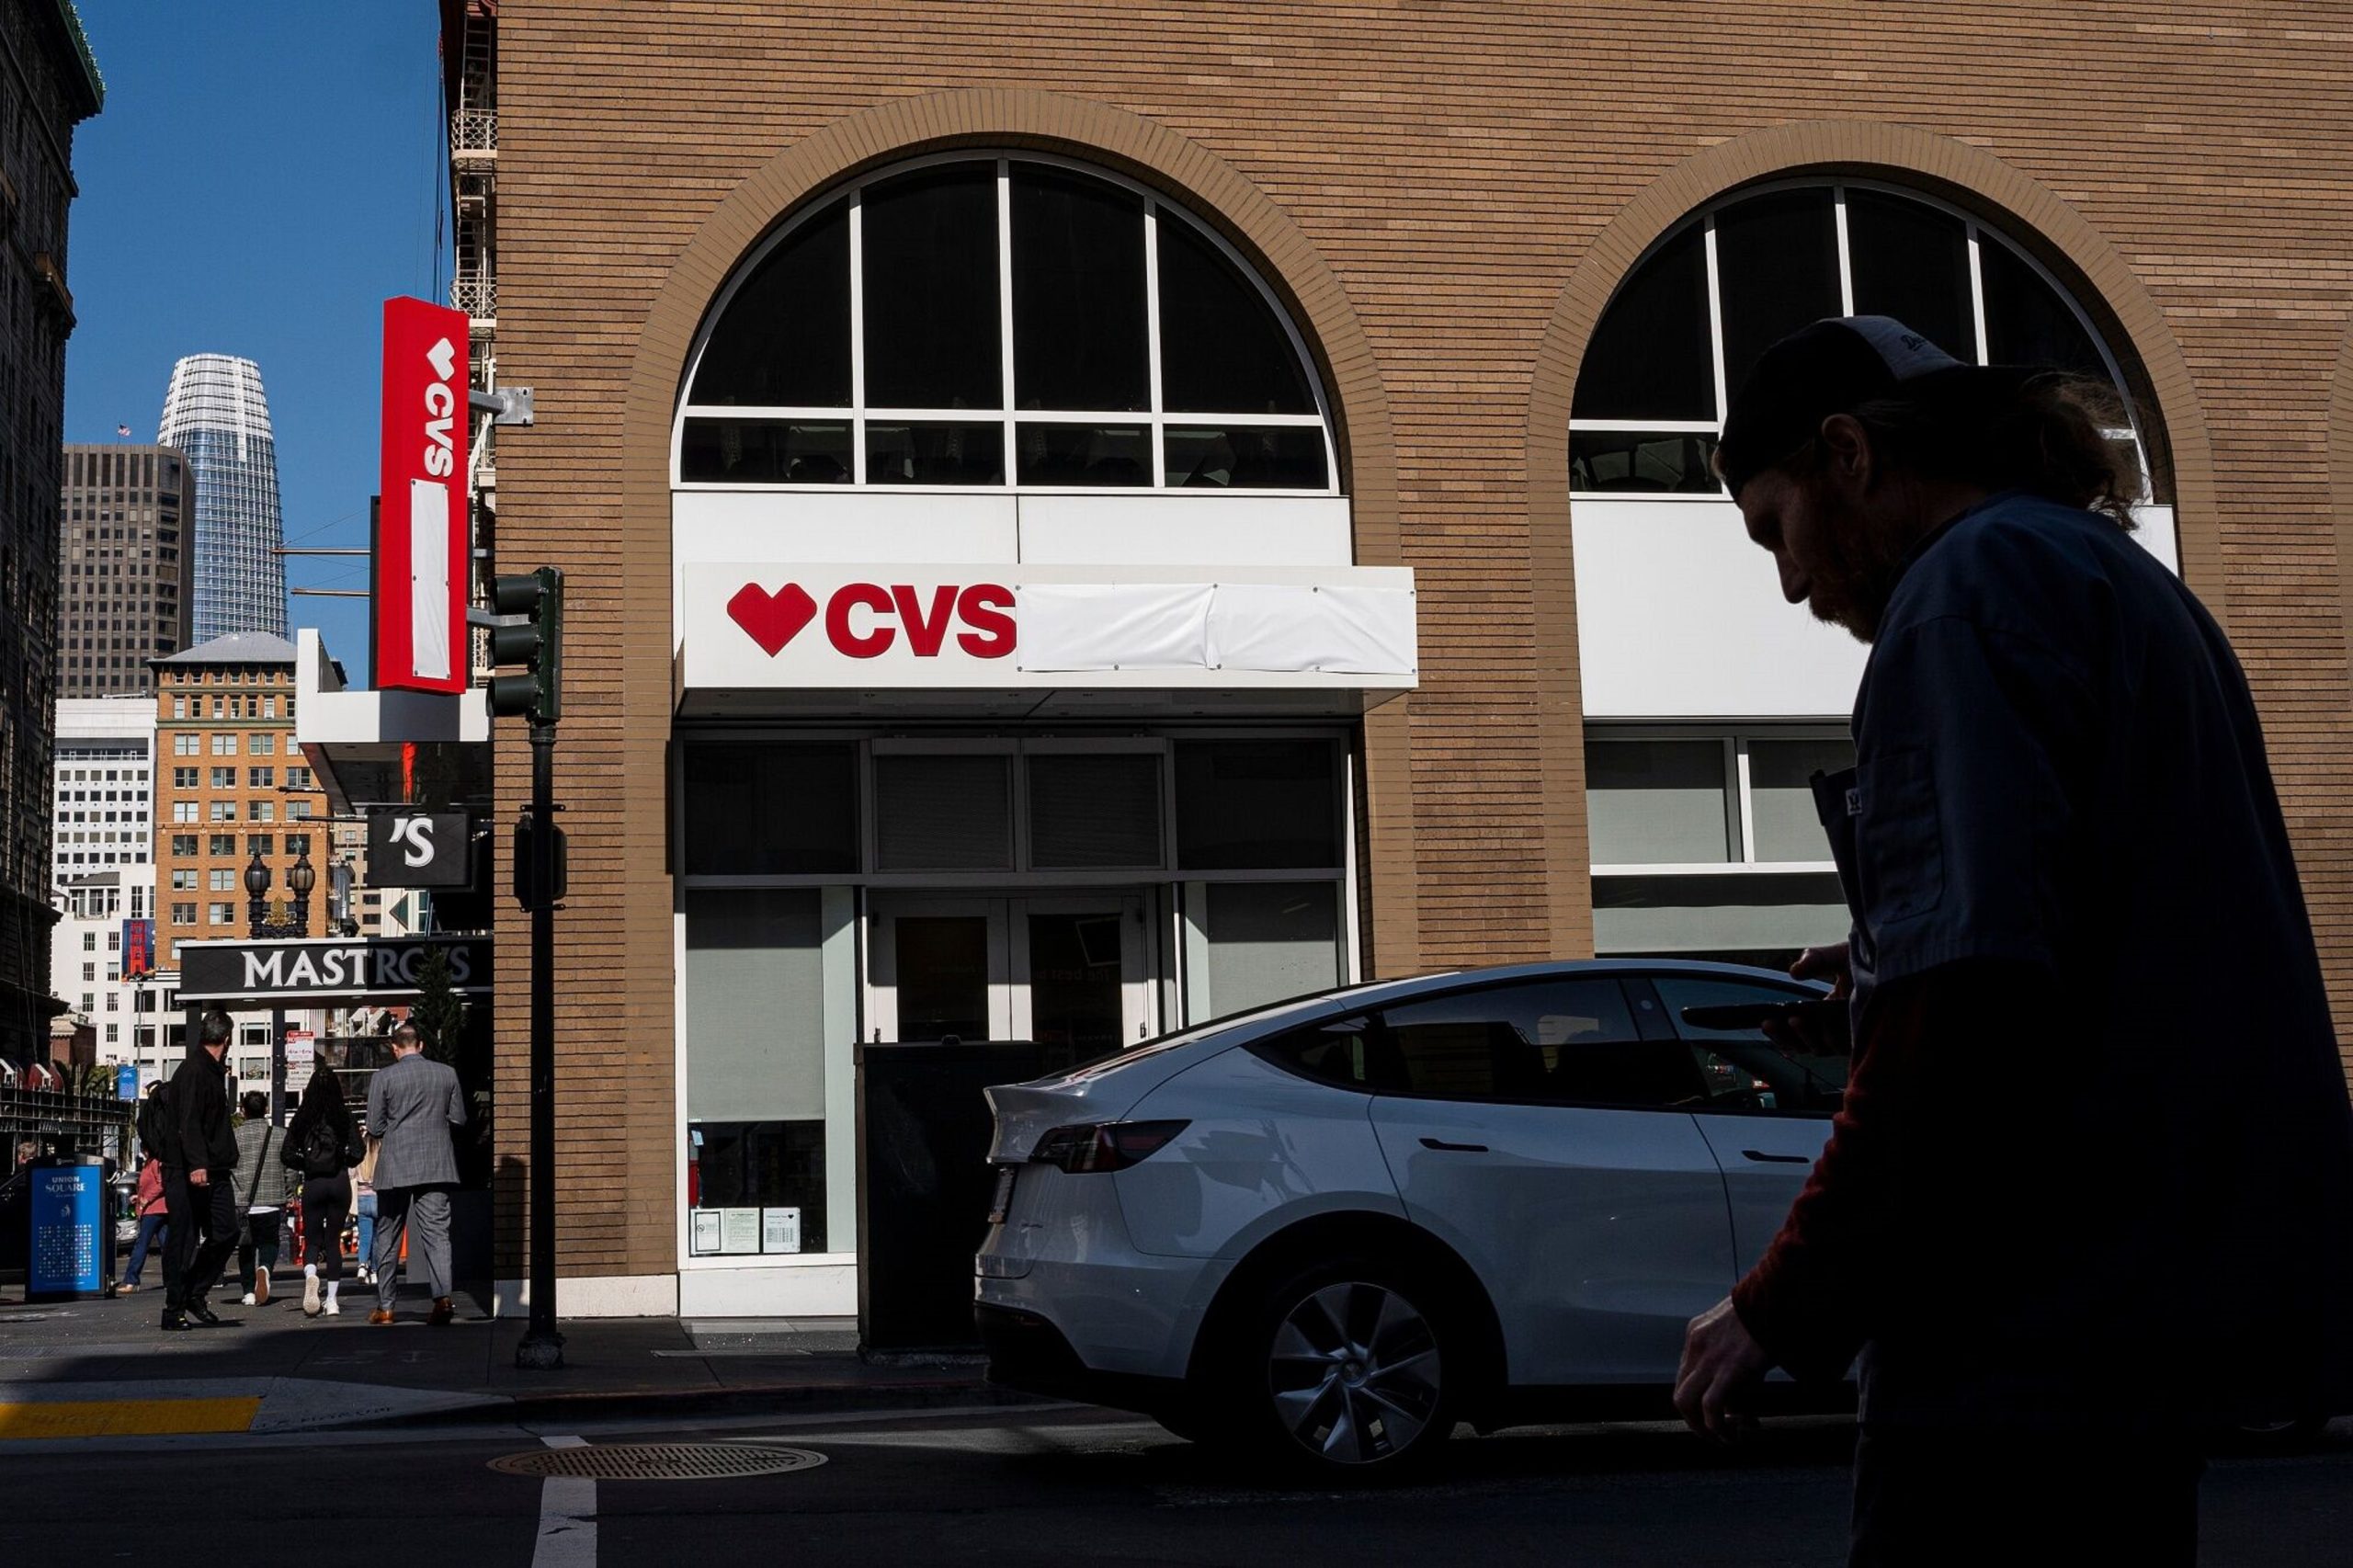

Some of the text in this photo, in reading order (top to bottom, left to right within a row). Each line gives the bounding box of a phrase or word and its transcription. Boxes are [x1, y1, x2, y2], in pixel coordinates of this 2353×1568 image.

[425, 382, 454, 477] CVS
[825, 583, 1017, 658] CVS
[45, 1183, 86, 1192] SQUARE
[51, 1176, 80, 1184] UNION
